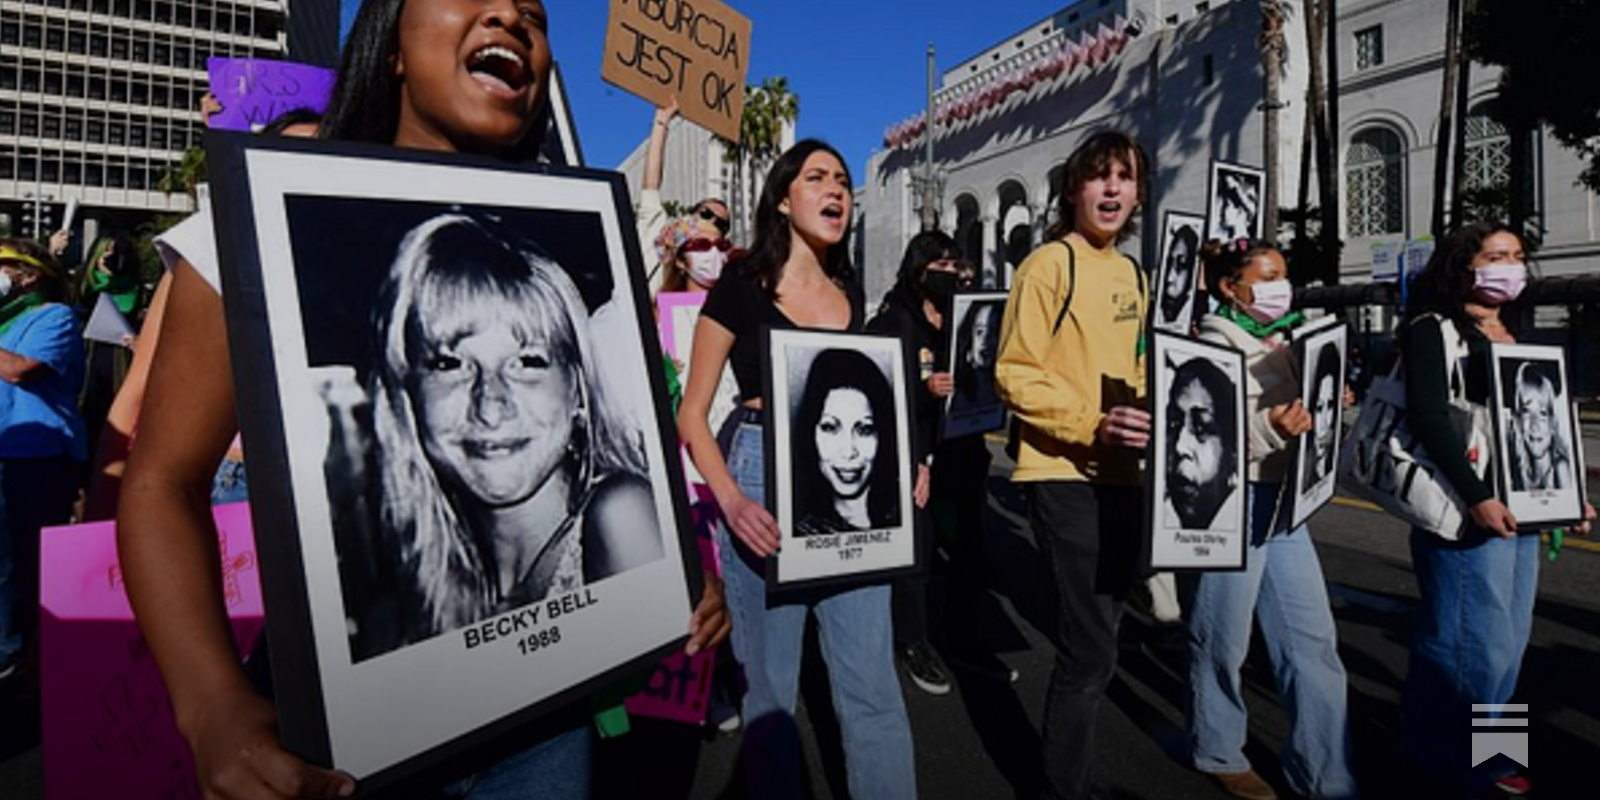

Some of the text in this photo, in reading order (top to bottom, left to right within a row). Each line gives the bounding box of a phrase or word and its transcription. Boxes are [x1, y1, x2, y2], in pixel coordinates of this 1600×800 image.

[622, 0, 739, 69] BORCJA
[616, 22, 736, 118] JEST OK
[463, 589, 599, 649] BECKY BELL
[517, 626, 561, 656] 1988
